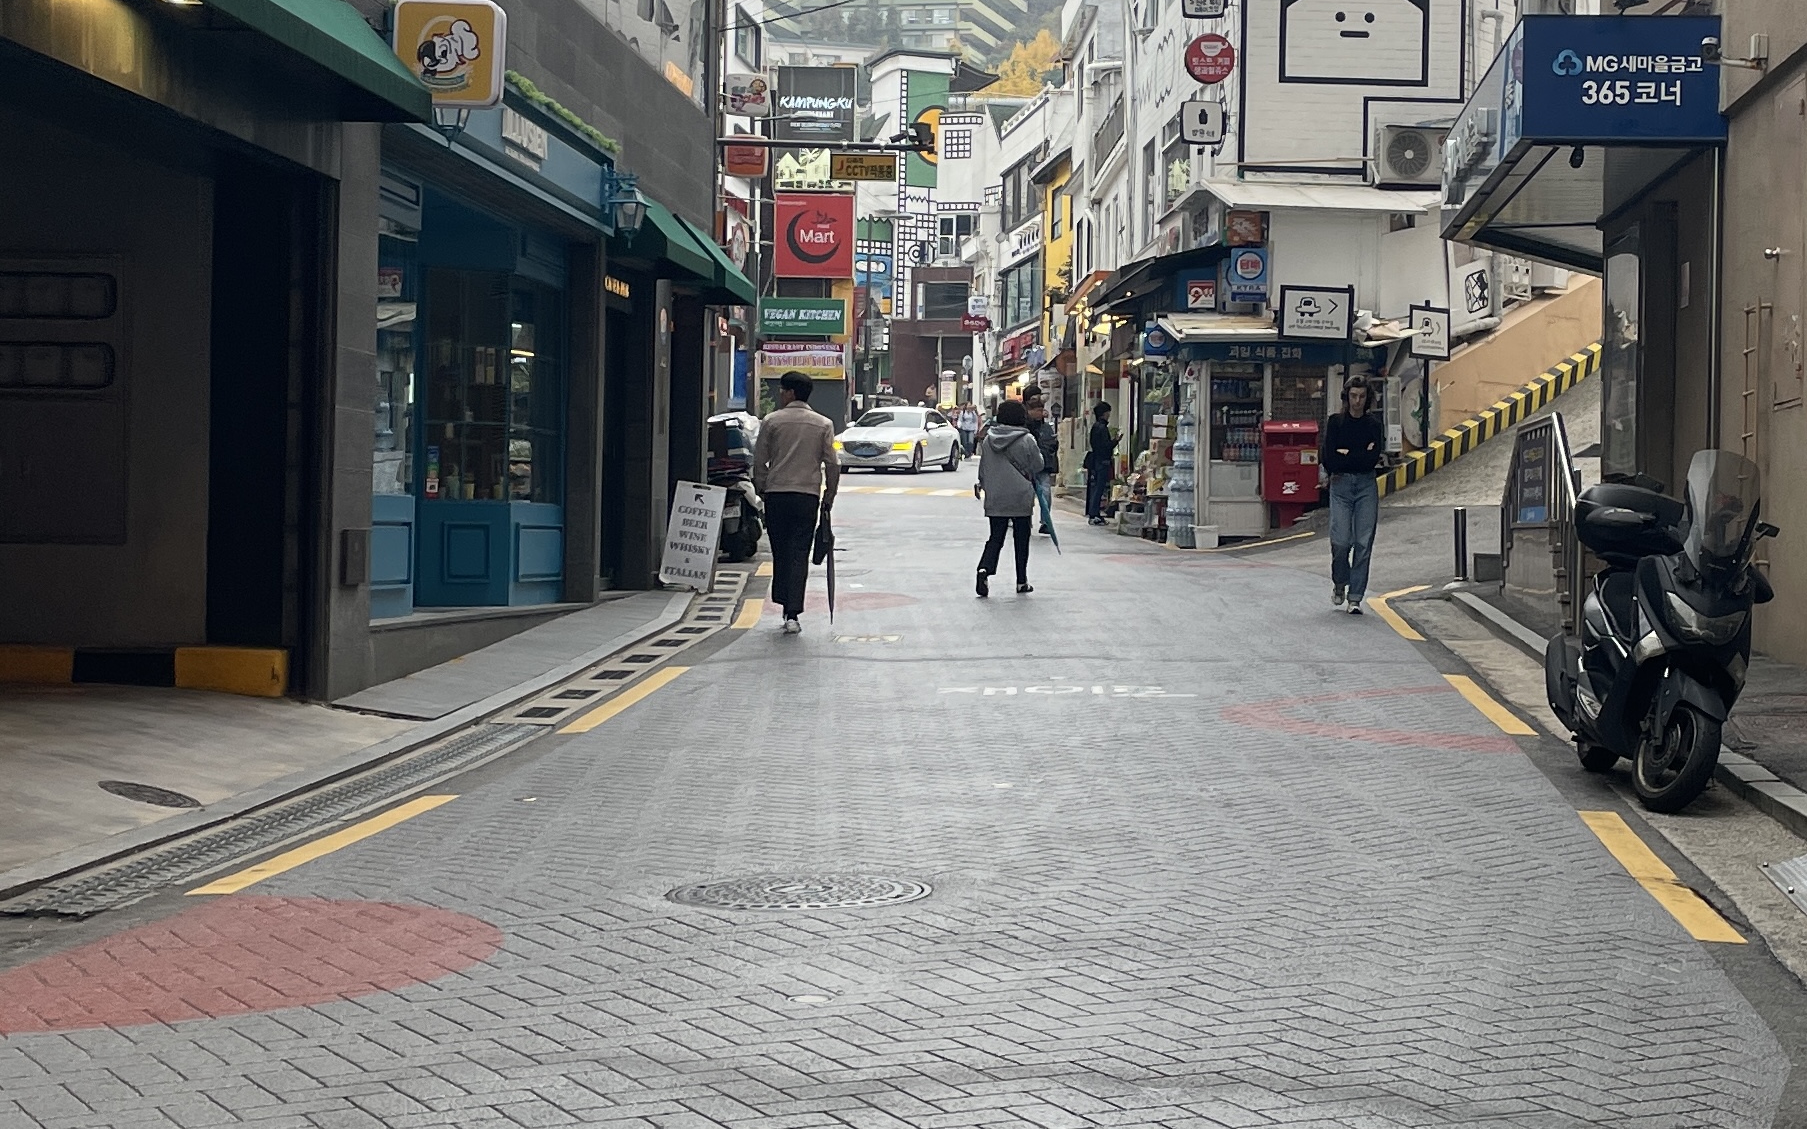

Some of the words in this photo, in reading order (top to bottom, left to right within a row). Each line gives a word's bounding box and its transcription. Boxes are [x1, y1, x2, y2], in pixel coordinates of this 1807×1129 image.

[1585, 55, 1704, 74] MG새마을금고
[1581, 80, 1631, 105] 365
[1634, 79, 1681, 107] 코너
[779, 95, 854, 110] KAMPUNGKU
[799, 228, 835, 244] Mart
[764, 308, 798, 320] VEGAN
[798, 309, 841, 321] KITCHEN
[677, 505, 717, 519] COFFEE
[681, 518, 708, 530] BEER
[679, 530, 707, 543] WINE
[664, 565, 707, 580] ITALIAN
